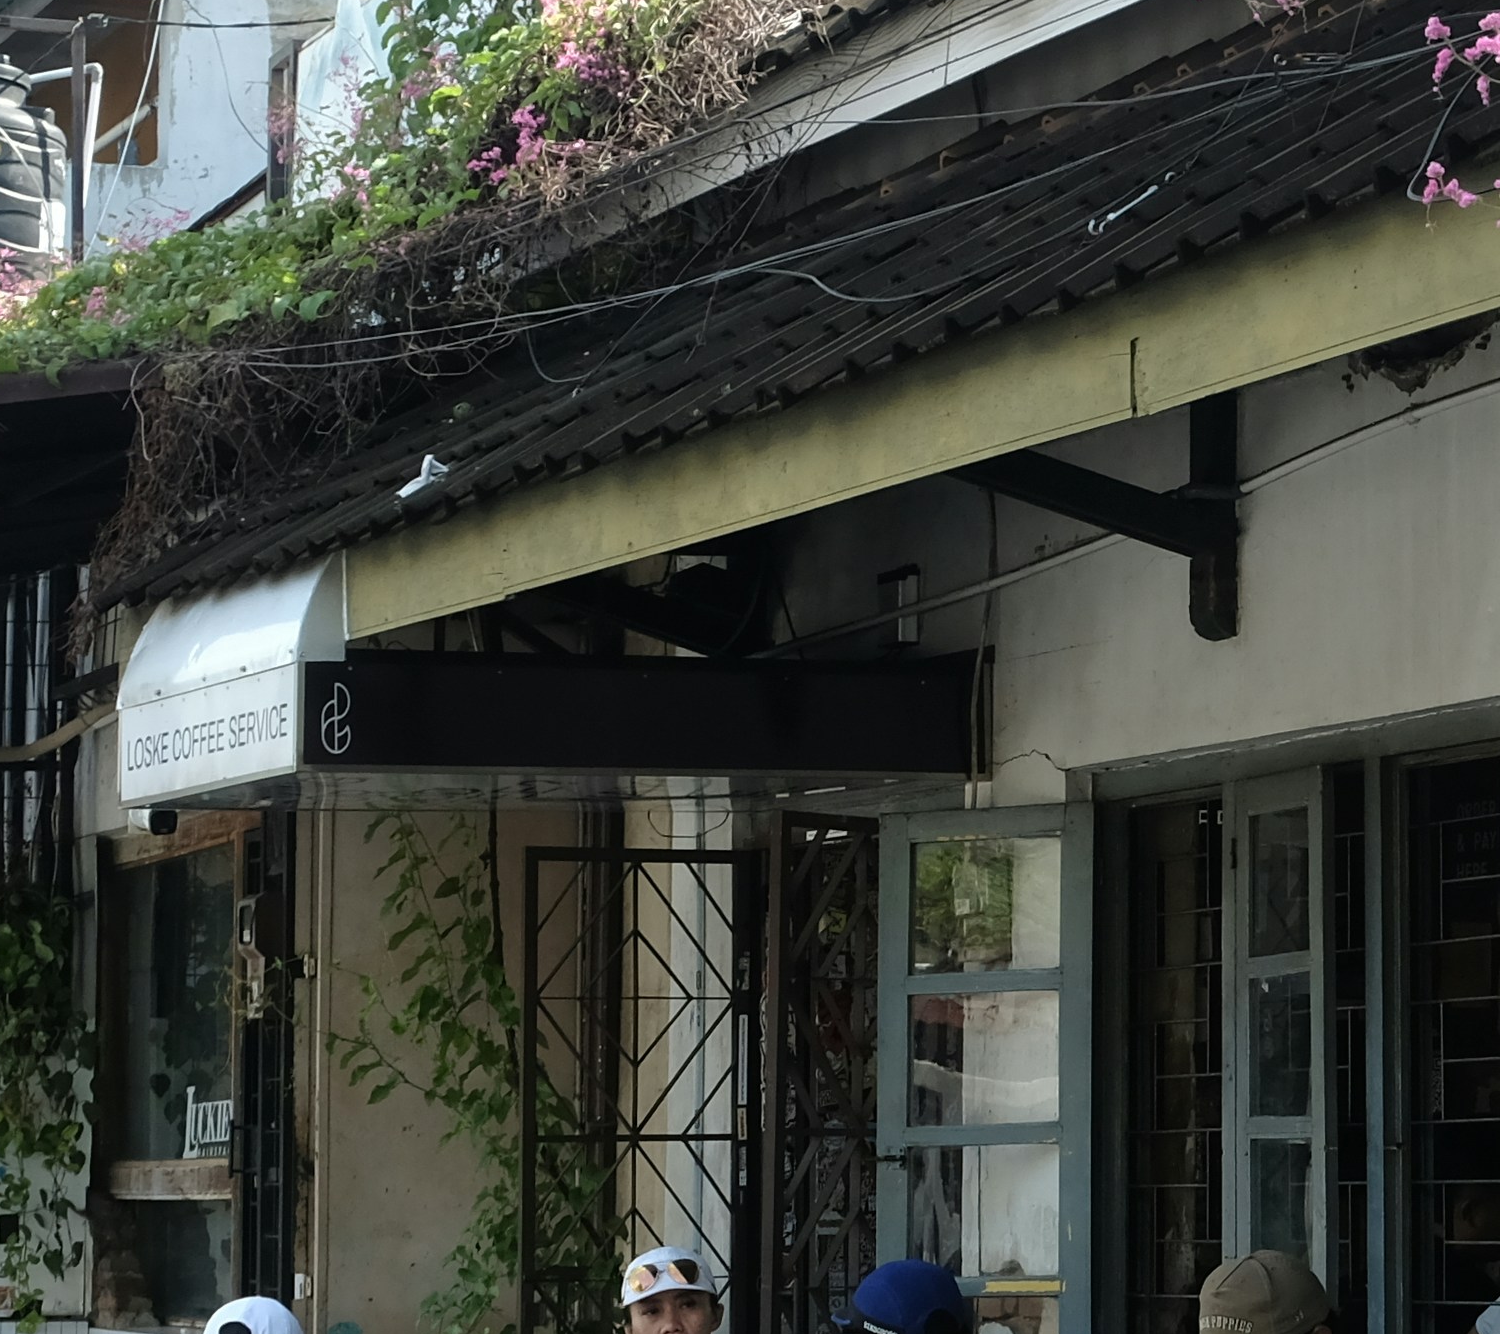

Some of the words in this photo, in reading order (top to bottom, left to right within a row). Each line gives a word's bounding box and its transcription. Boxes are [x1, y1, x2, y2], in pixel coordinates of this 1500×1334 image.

[127, 732, 169, 771] LOSKE
[172, 718, 225, 761] COFFEE
[228, 703, 288, 749] SERVICE
